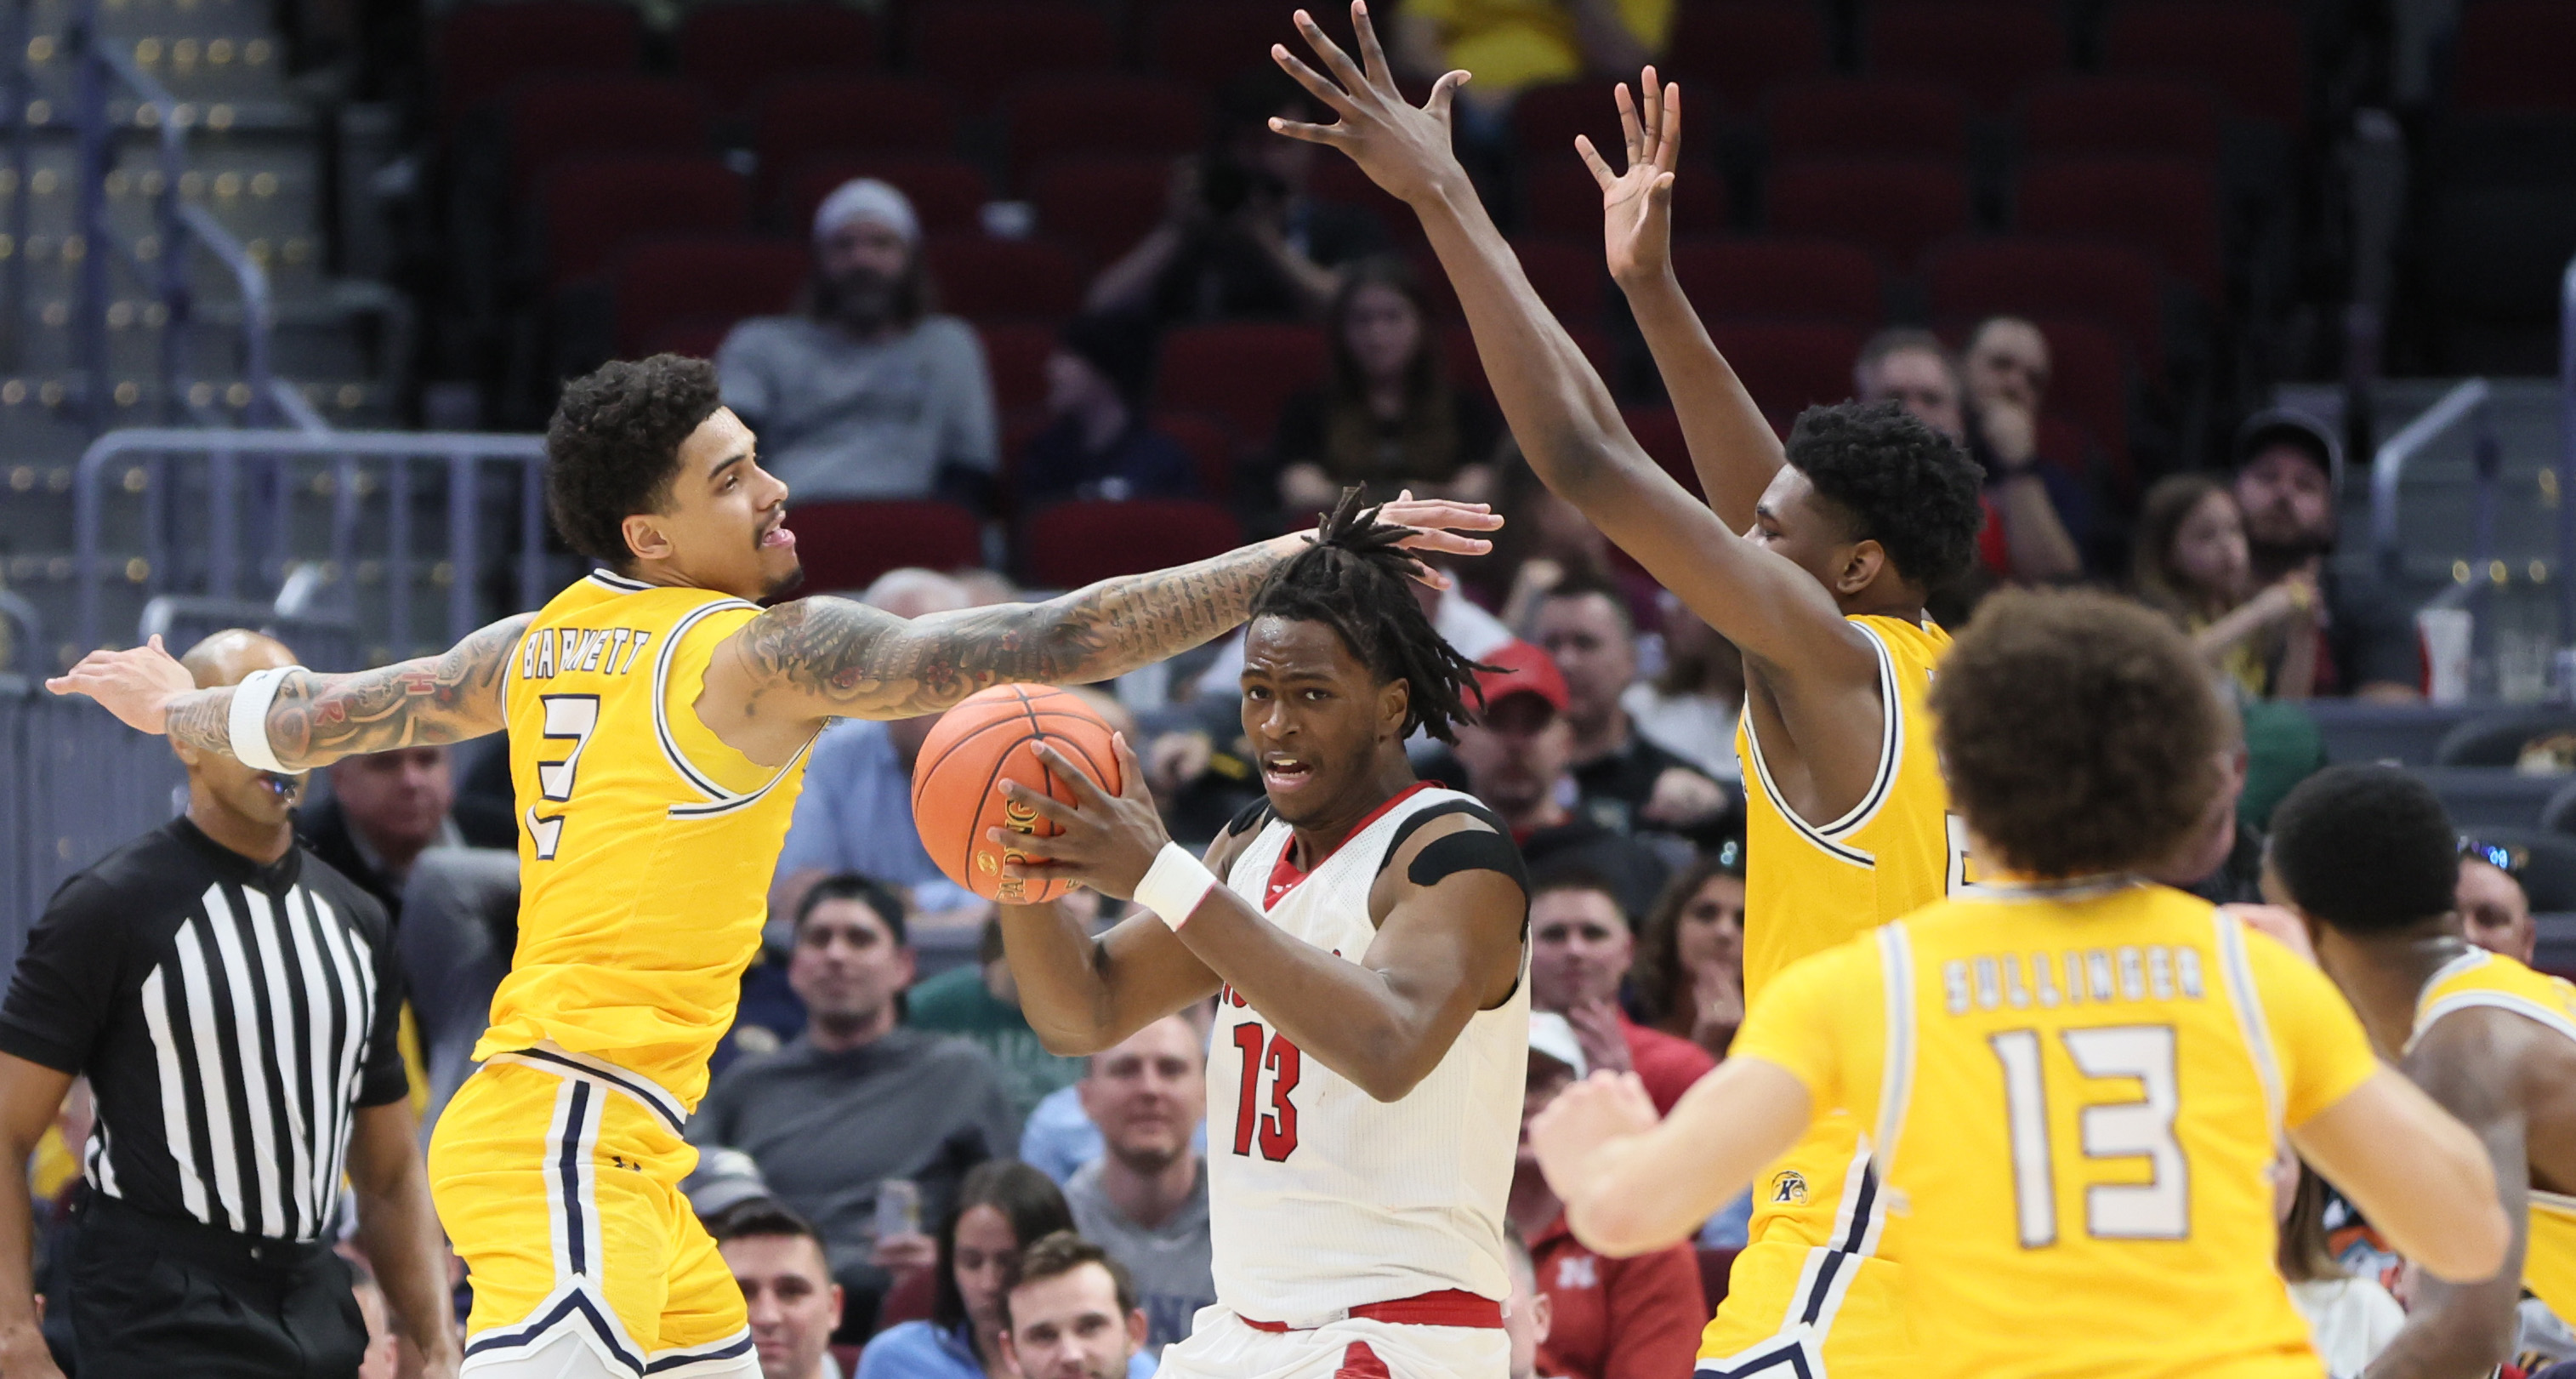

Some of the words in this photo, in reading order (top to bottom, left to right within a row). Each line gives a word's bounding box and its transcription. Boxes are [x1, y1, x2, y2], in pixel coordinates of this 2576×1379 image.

[522, 627, 652, 680] BARNETT
[524, 693, 601, 861] 2
[1942, 943, 2206, 1018] SULLINGER
[1232, 1021, 1301, 1164] 13
[1985, 1023, 2192, 1251] 13
